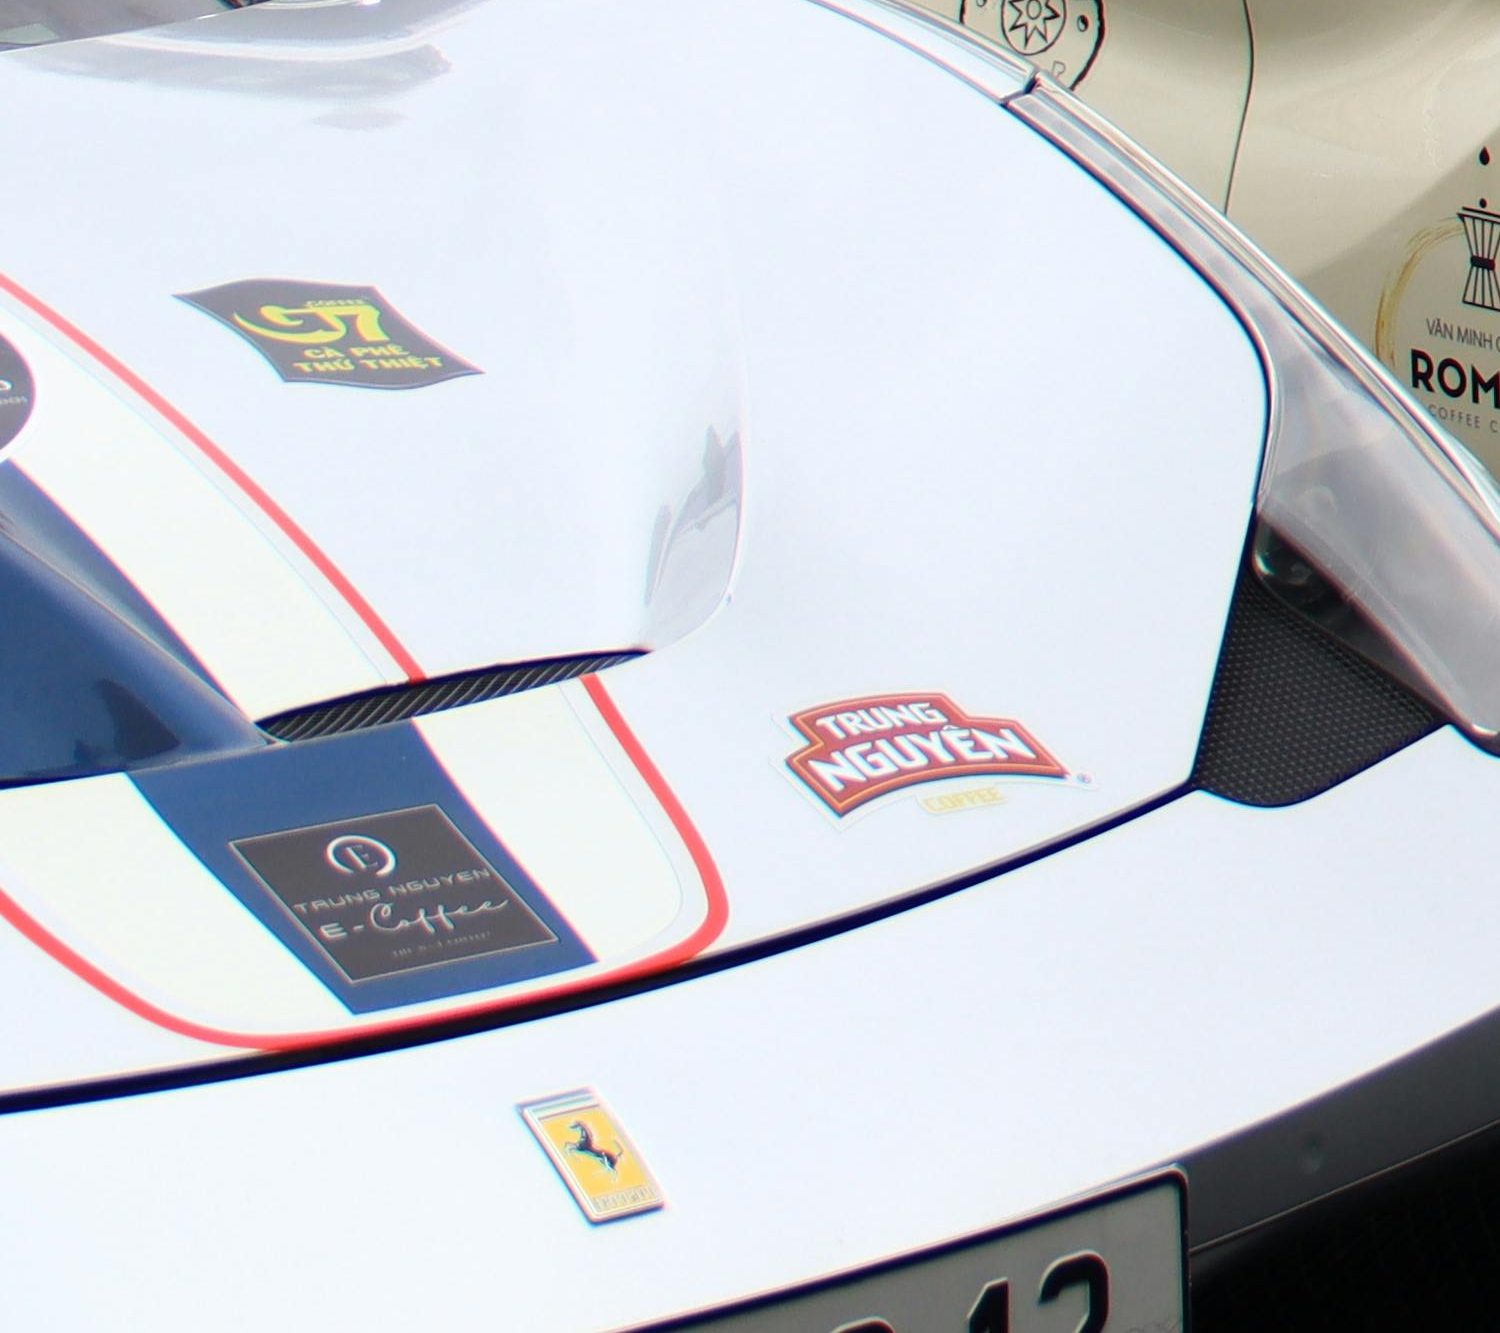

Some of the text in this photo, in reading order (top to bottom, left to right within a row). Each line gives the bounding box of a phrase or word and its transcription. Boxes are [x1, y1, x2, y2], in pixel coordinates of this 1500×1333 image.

[232, 304, 391, 345] G7
[1425, 316, 1455, 341] VĂN
[1456, 326, 1494, 350] MINH
[302, 343, 411, 359] CÀ PHÊ
[1427, 402, 1482, 431] COFFEE
[809, 701, 1040, 793] TRUNG NGUYÊN
[922, 784, 1007, 814] COFFEE
[292, 864, 493, 916] TRUNG NGUYEN
[318, 897, 513, 941] E-Coffee
